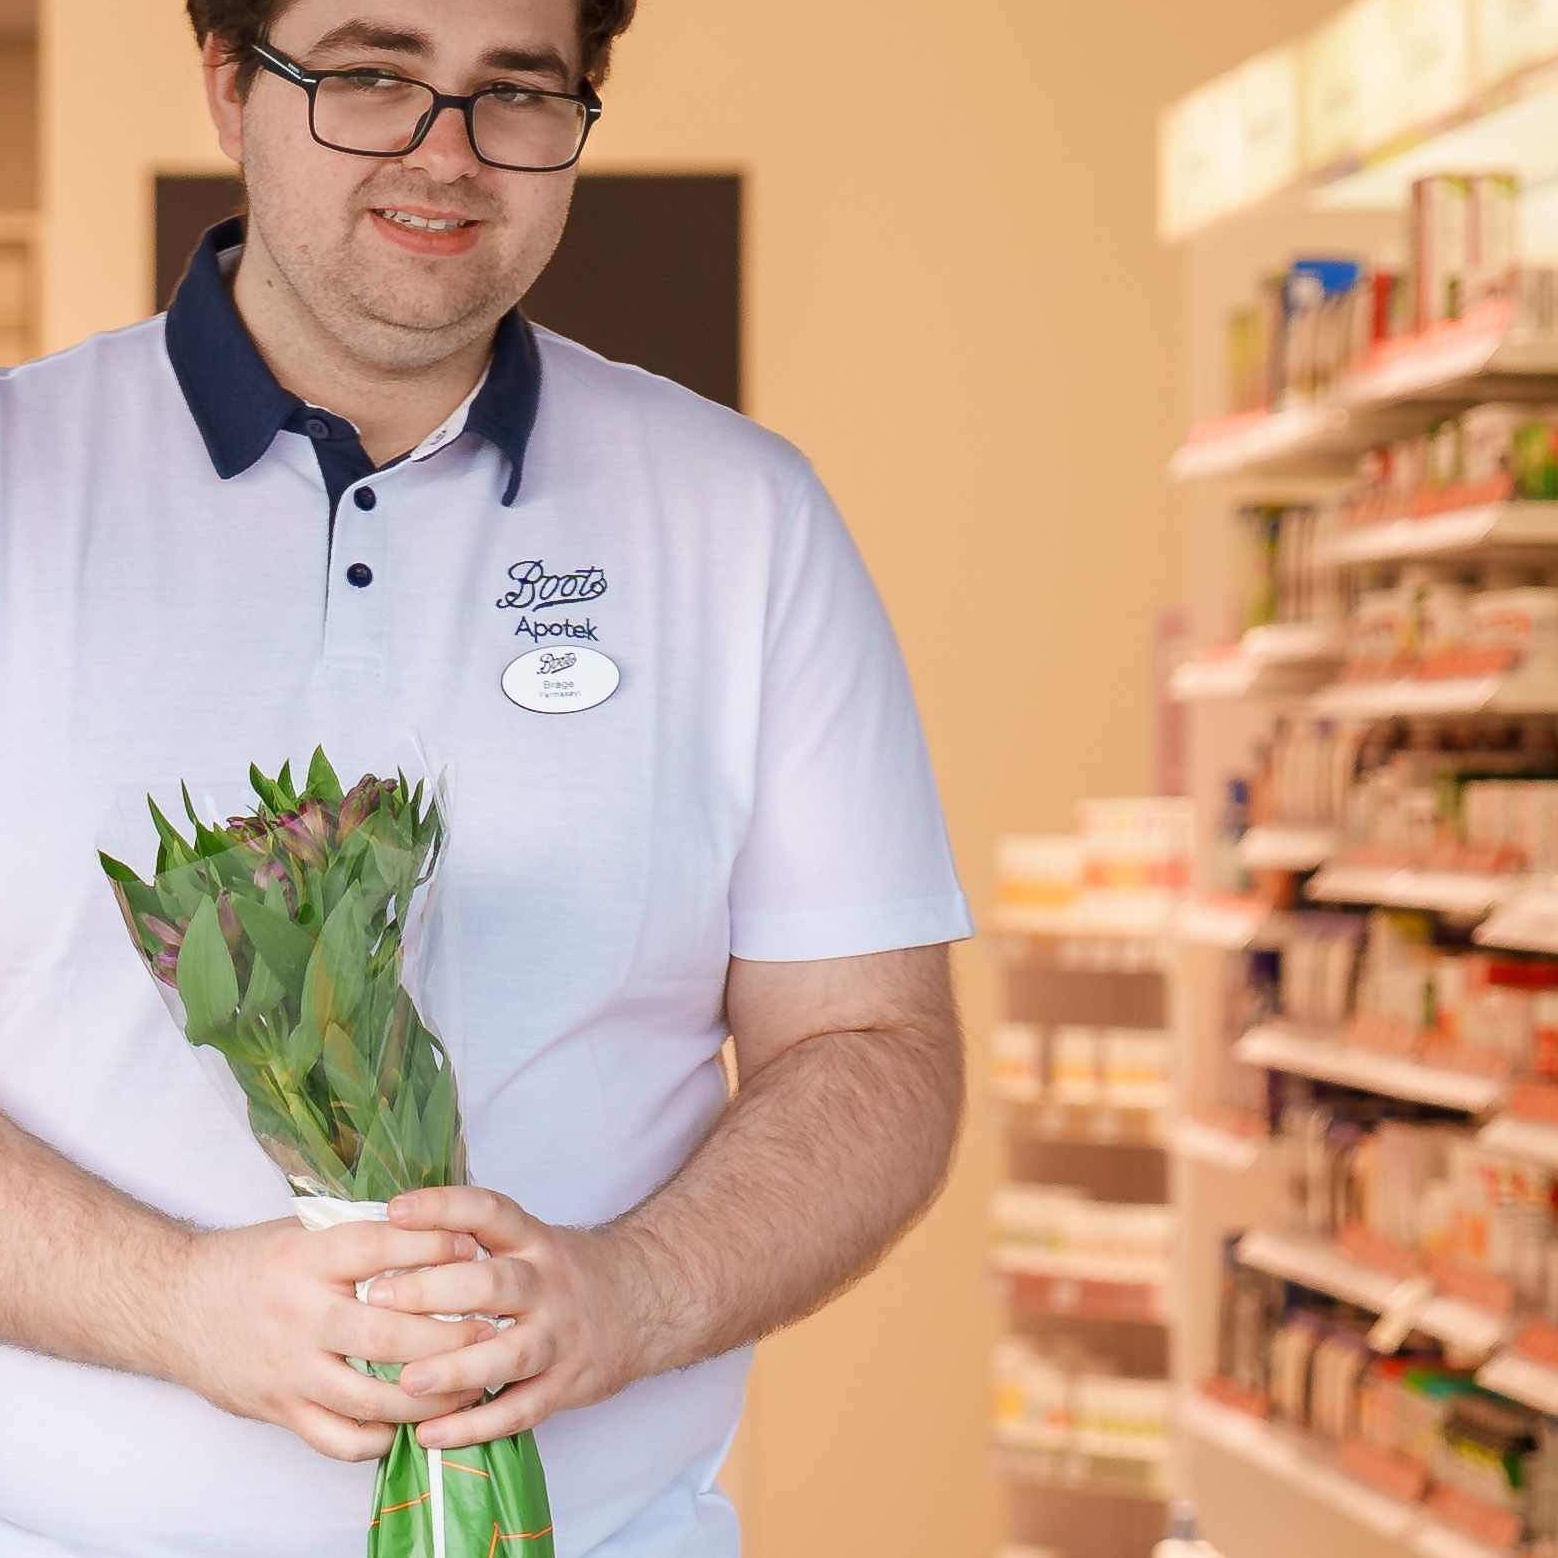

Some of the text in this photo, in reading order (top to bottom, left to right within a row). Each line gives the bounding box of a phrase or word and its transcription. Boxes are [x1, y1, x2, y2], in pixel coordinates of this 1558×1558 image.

[496, 559, 607, 612] Boots
[514, 616, 599, 643] Apotek
[536, 652, 577, 674] Boots
